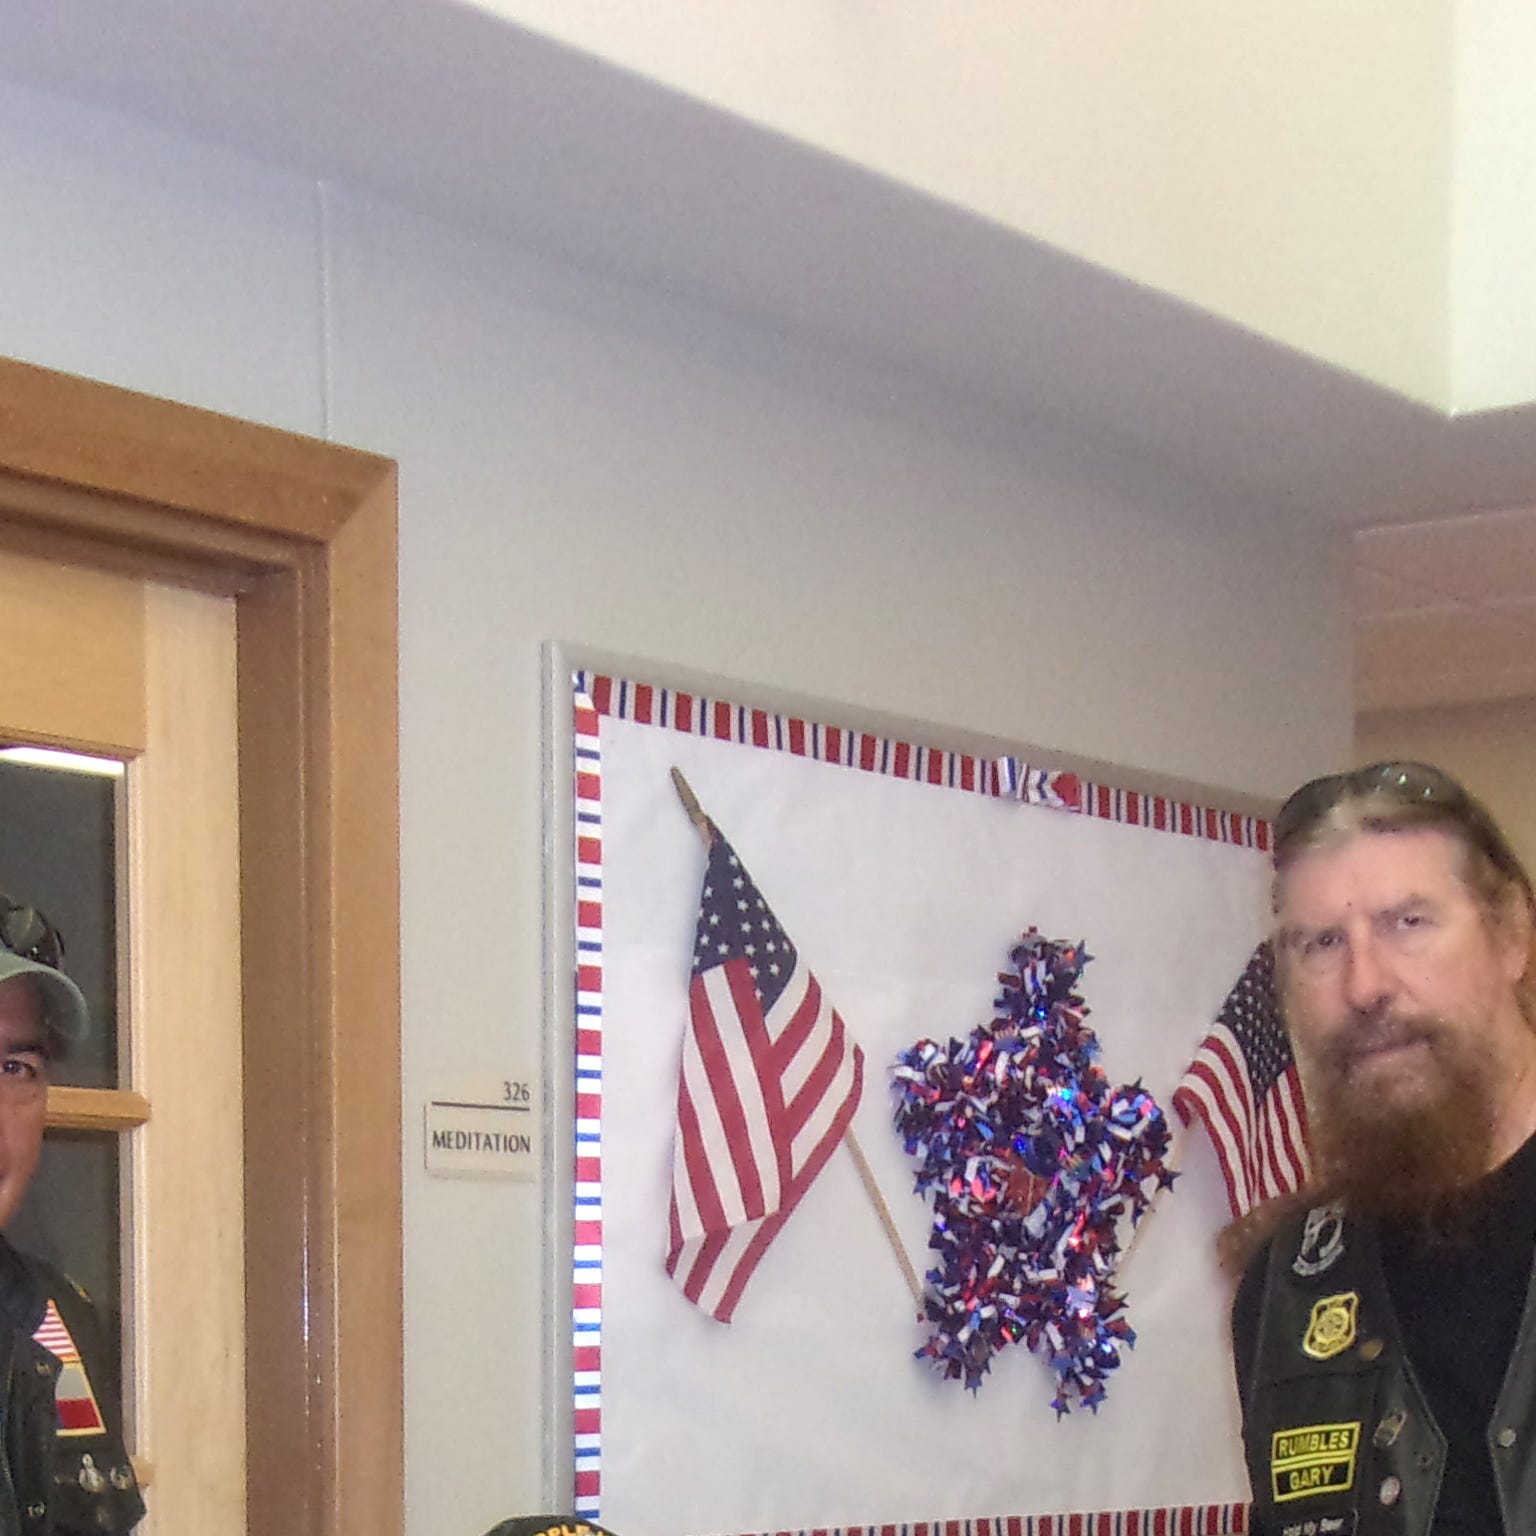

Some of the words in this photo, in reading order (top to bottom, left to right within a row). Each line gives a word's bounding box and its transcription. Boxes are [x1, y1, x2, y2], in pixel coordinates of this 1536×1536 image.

[503, 1081, 531, 1102] 326
[431, 1130, 532, 1154] MEDITATION
[1279, 1430, 1350, 1458] RUMBLES
[1289, 1466, 1334, 1490] GARY
